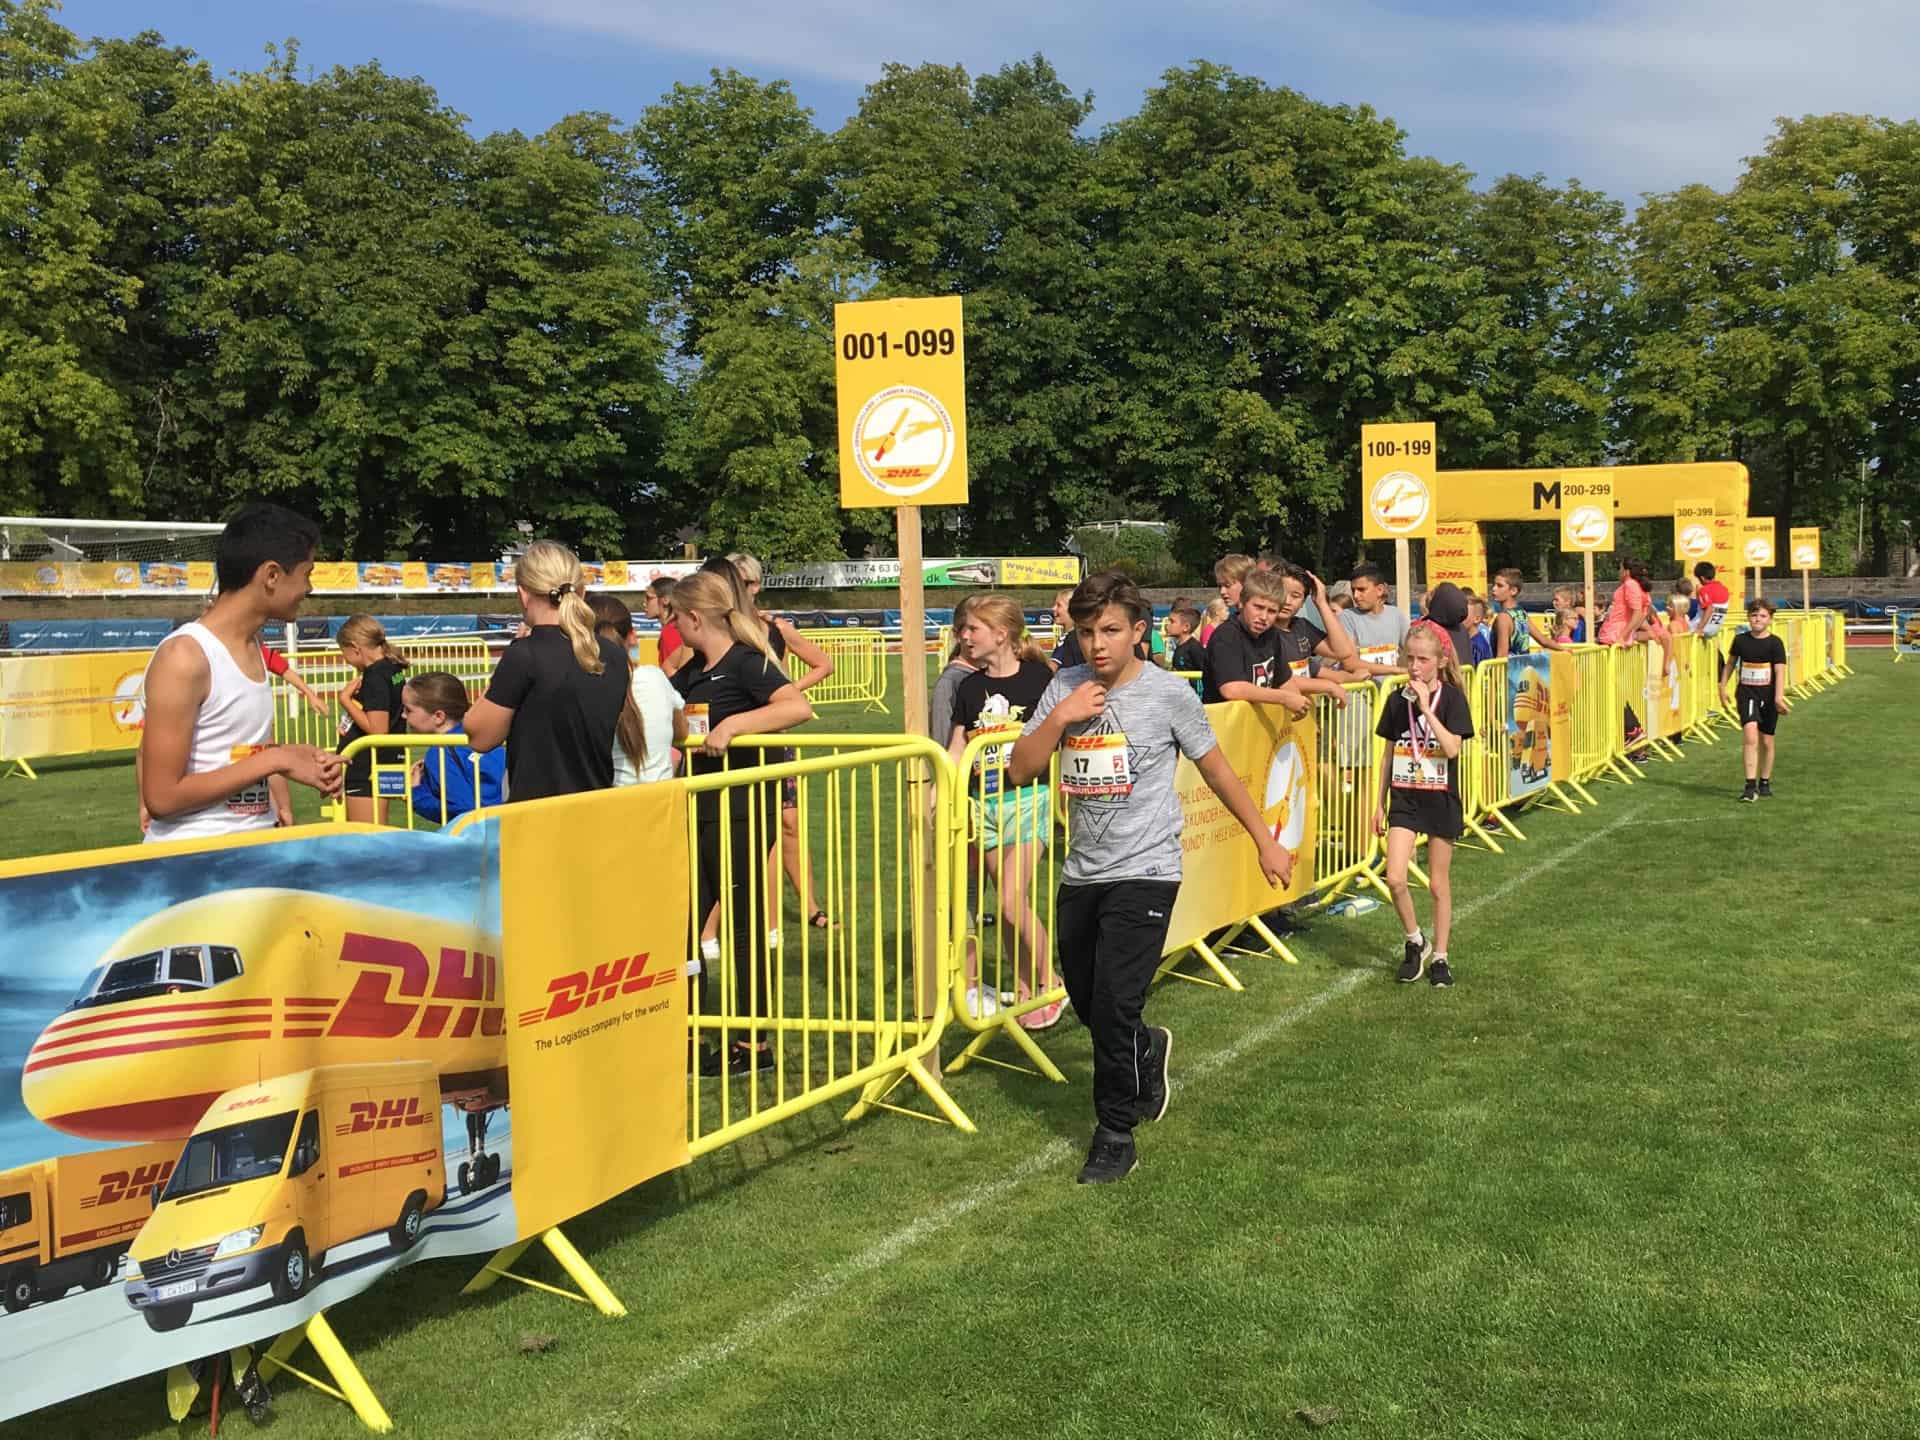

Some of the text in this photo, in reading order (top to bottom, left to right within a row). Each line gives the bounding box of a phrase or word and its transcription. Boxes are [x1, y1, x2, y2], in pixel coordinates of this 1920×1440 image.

[843, 328, 954, 360] 001-099
[1368, 440, 1431, 456] 100-199
[1564, 484, 1610, 496] 200-299
[1677, 508, 1713, 517] 300-399
[864, 564, 876, 573] 74
[879, 564, 890, 573] 63
[763, 575, 825, 587] Turistfart
[1067, 736, 1105, 749] DHL
[1073, 757, 1089, 773] 17
[544, 951, 657, 1021] DHL
[535, 999, 670, 1051] The Logistics company for the world
[350, 1097, 425, 1133] DHL
